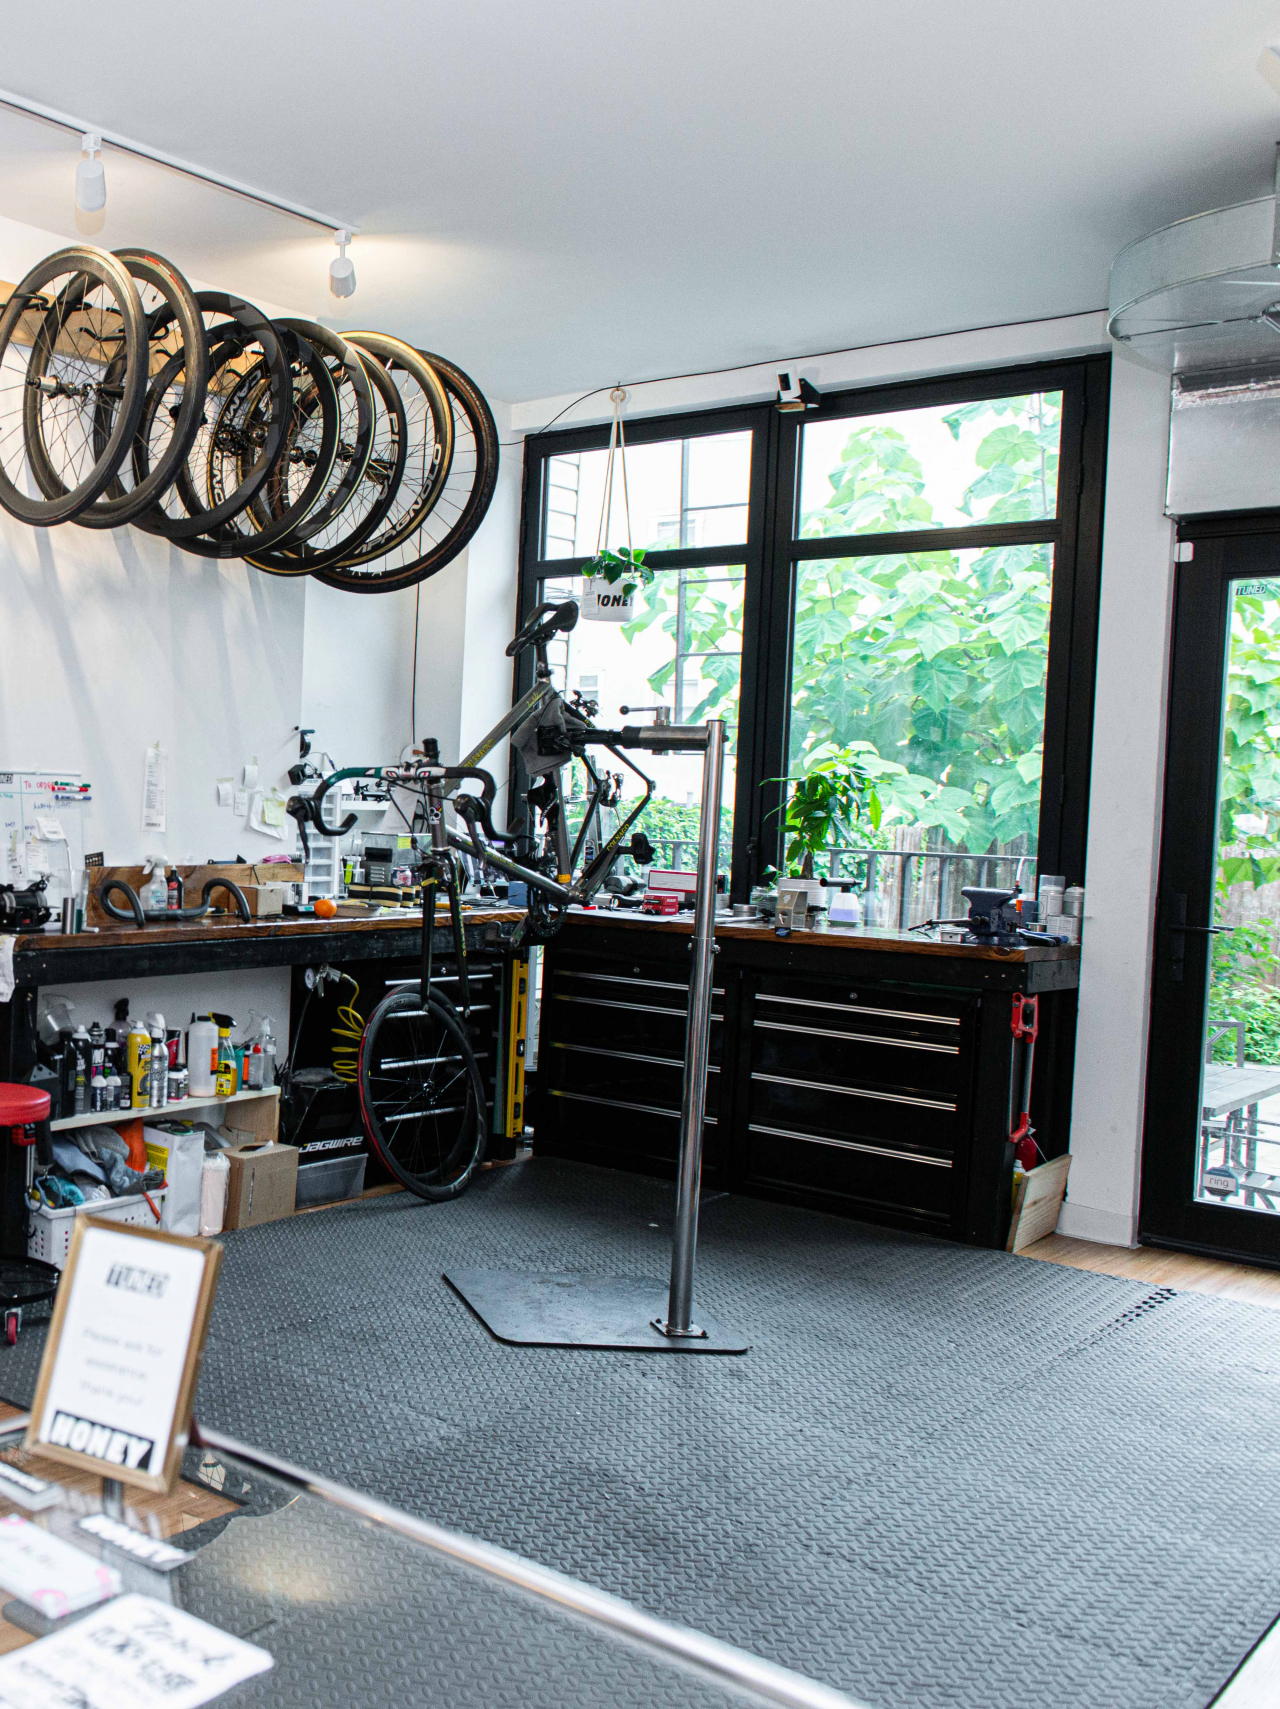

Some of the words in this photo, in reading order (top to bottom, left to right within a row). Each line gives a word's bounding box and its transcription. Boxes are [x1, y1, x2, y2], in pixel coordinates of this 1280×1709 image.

[1236, 584, 1267, 596] TUNED
[597, 594, 632, 607] ONE
[463, 738, 496, 768] OLNAGO
[23, 781, 32, 789] TO
[606, 823, 630, 852] COLNAGO
[298, 1136, 364, 1154] JAGWIRE
[1209, 1177, 1229, 1189] ring
[51, 1413, 151, 1470] HONEY
